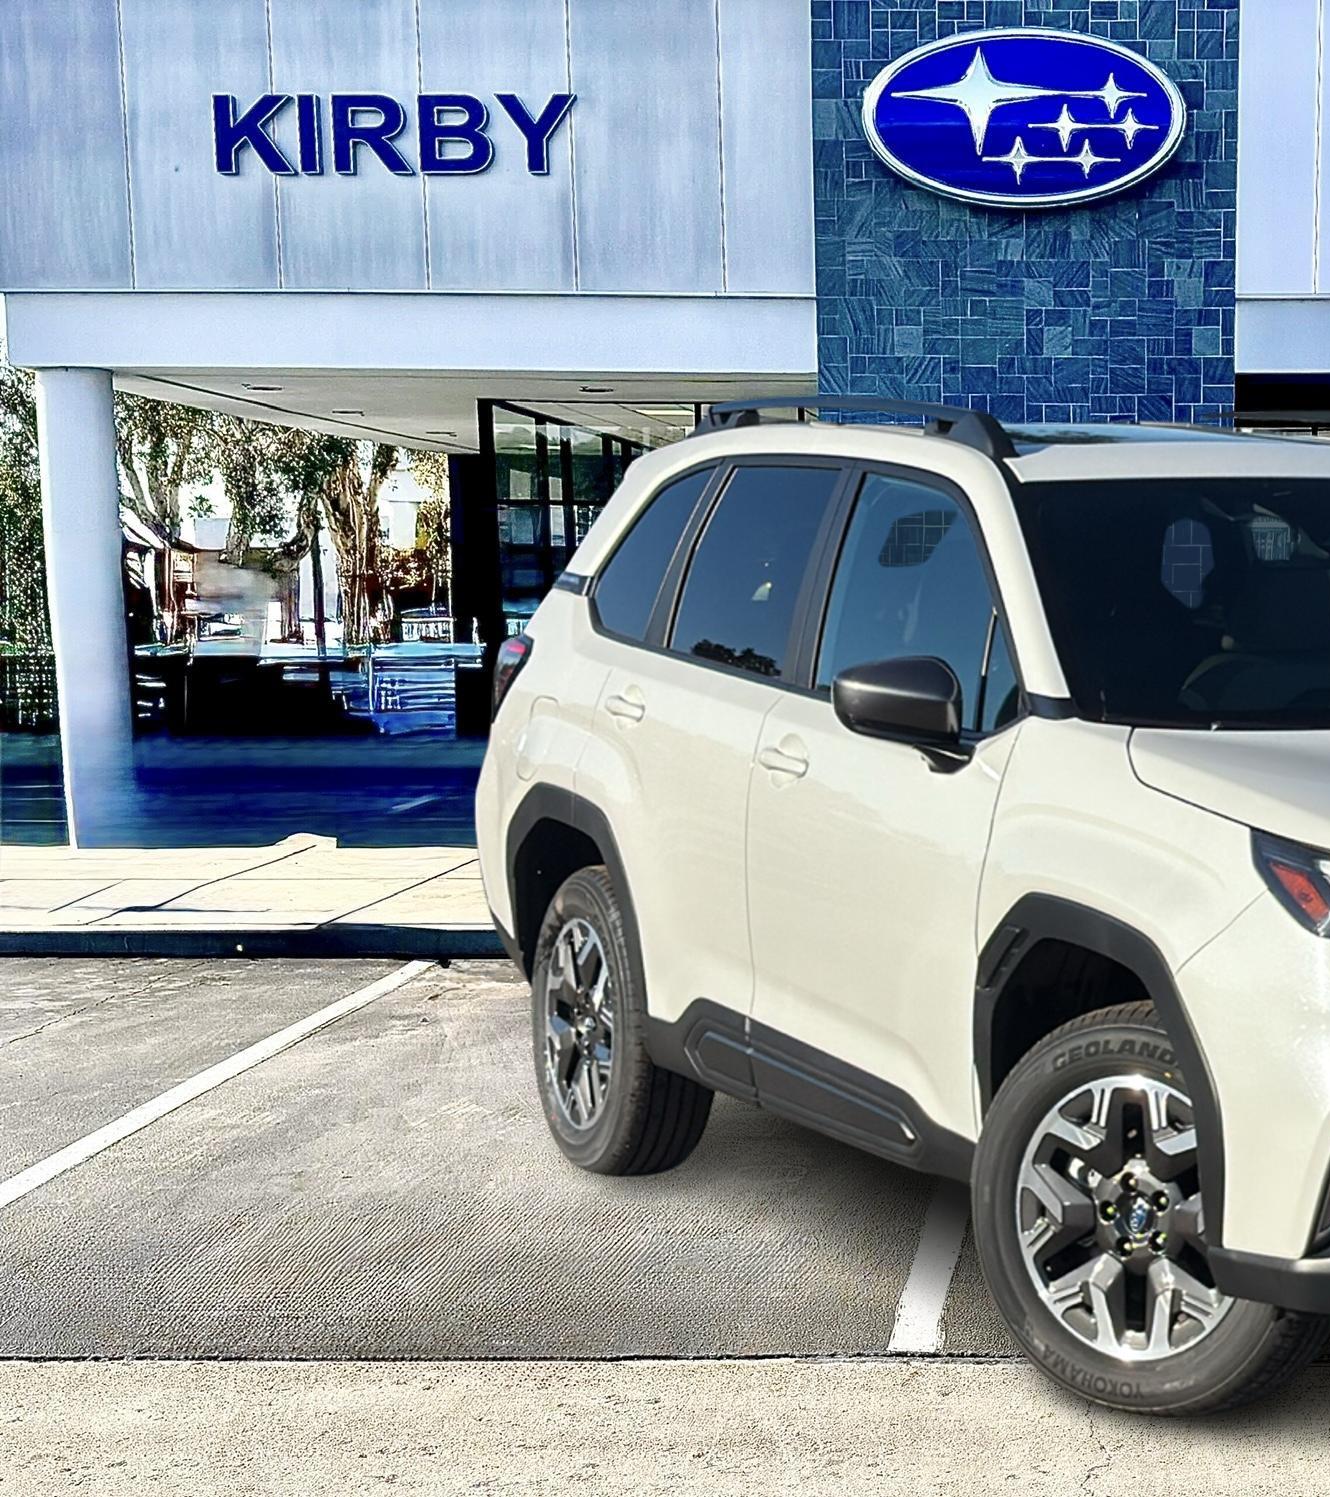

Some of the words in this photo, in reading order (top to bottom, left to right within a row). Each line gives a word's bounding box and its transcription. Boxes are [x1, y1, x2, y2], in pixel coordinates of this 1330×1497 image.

[212, 93, 577, 175] KIRBY
[1051, 1039, 1179, 1071] GEOLAND
[1040, 1343, 1144, 1399] YOKOHAMA
